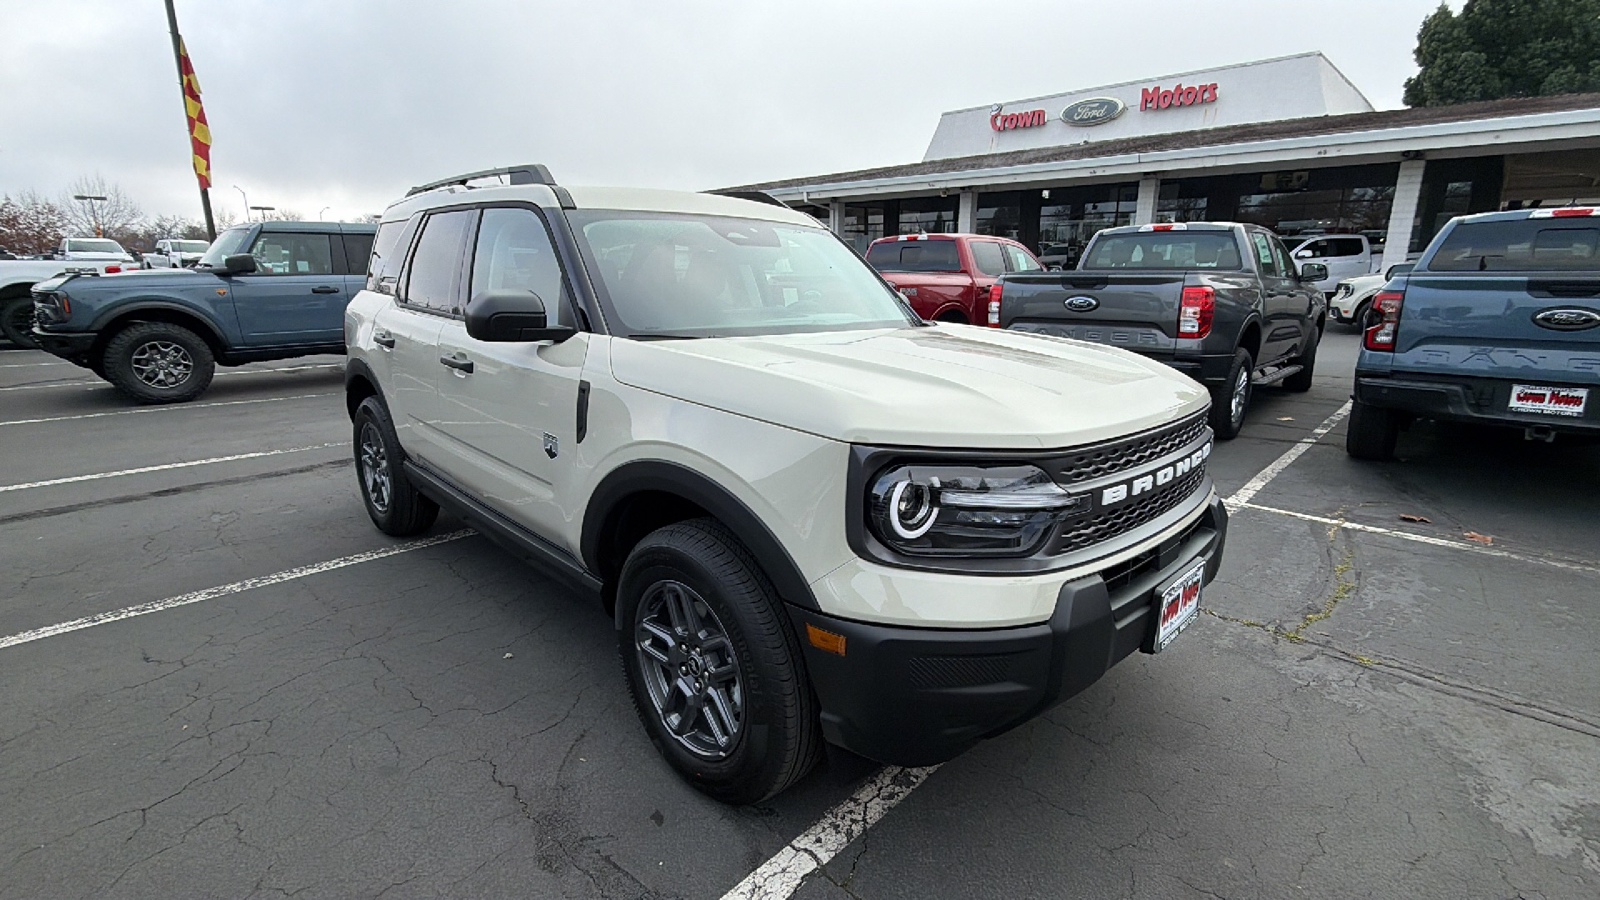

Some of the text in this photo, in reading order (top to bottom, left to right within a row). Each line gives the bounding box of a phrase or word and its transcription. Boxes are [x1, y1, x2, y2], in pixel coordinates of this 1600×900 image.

[990, 82, 1218, 131] Crown Motors
[1073, 103, 1108, 120] Ford
[1101, 442, 1211, 506] BRONCO
